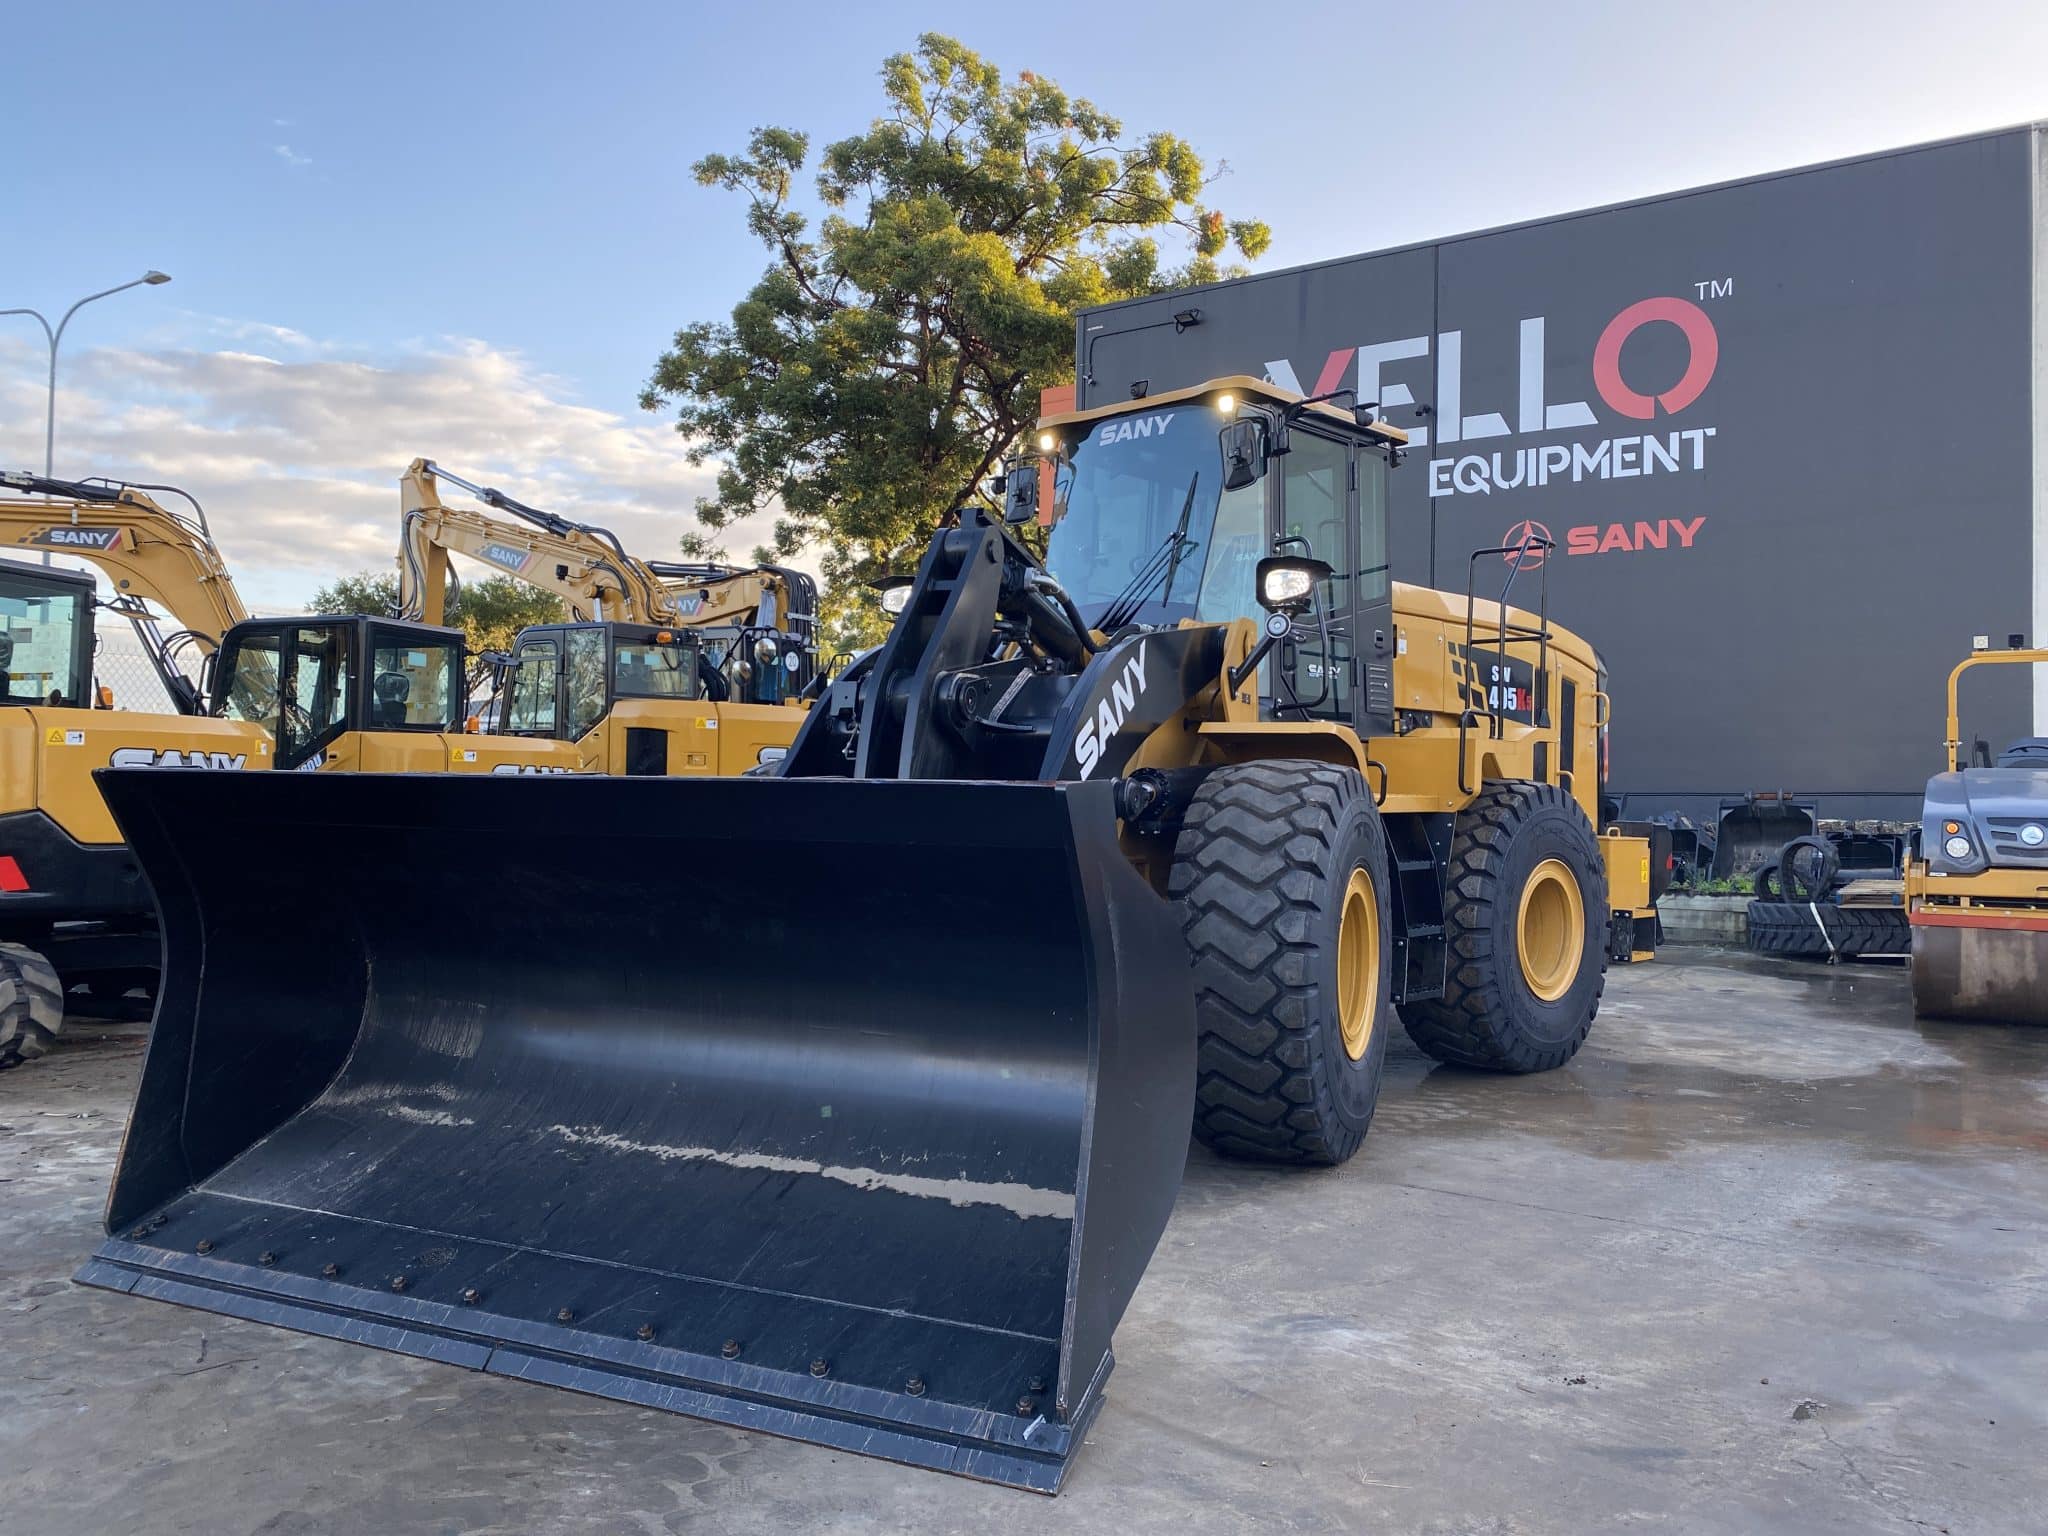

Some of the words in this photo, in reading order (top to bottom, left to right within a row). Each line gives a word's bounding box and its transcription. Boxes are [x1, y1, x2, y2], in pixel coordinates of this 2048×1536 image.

[1695, 278, 1733, 300] TM
[1099, 413, 1175, 446] SANY
[1429, 427, 1716, 497] EQUIPMENT
[50, 530, 109, 545] SANY
[1567, 516, 1708, 555] SANY
[490, 546, 522, 567] SANY
[1075, 640, 1146, 781] SANY
